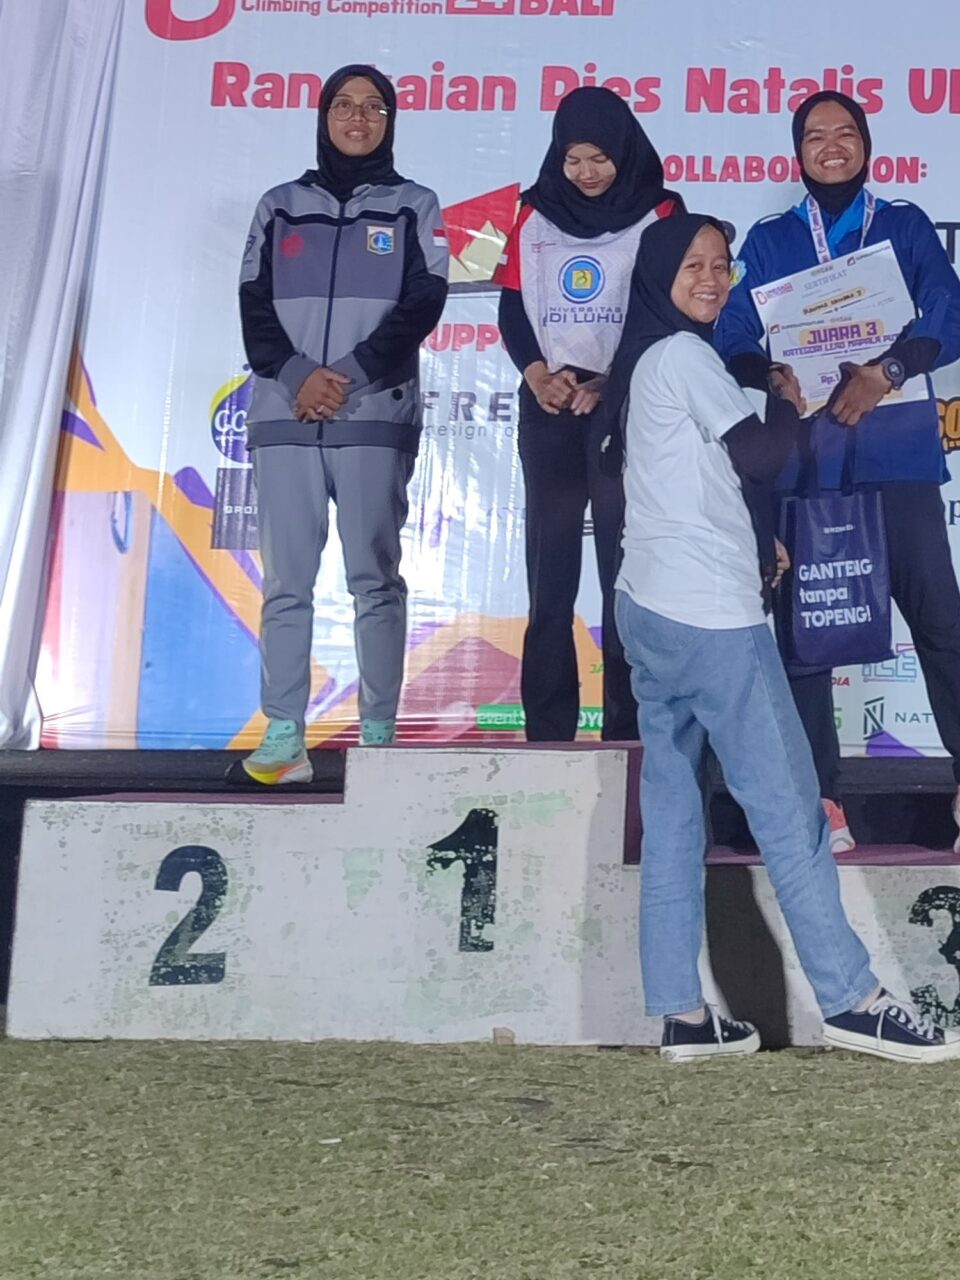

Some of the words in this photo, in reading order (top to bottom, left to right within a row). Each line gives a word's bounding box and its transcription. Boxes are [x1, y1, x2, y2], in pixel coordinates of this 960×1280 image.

[211, 61, 516, 112] Ranaian
[662, 154, 928, 184] OLLABOON:
[548, 306, 622, 314] NIVERSITAS
[574, 314, 623, 324] LUHU
[424, 323, 506, 352] UPP
[807, 323, 862, 345] JUARA
[864, 321, 878, 336] 3
[820, 373, 840, 385] Rp.1
[799, 586, 849, 606] tanpa
[801, 605, 873, 629] TOPENG!
[427, 807, 499, 952] 1
[149, 842, 229, 988] 2
